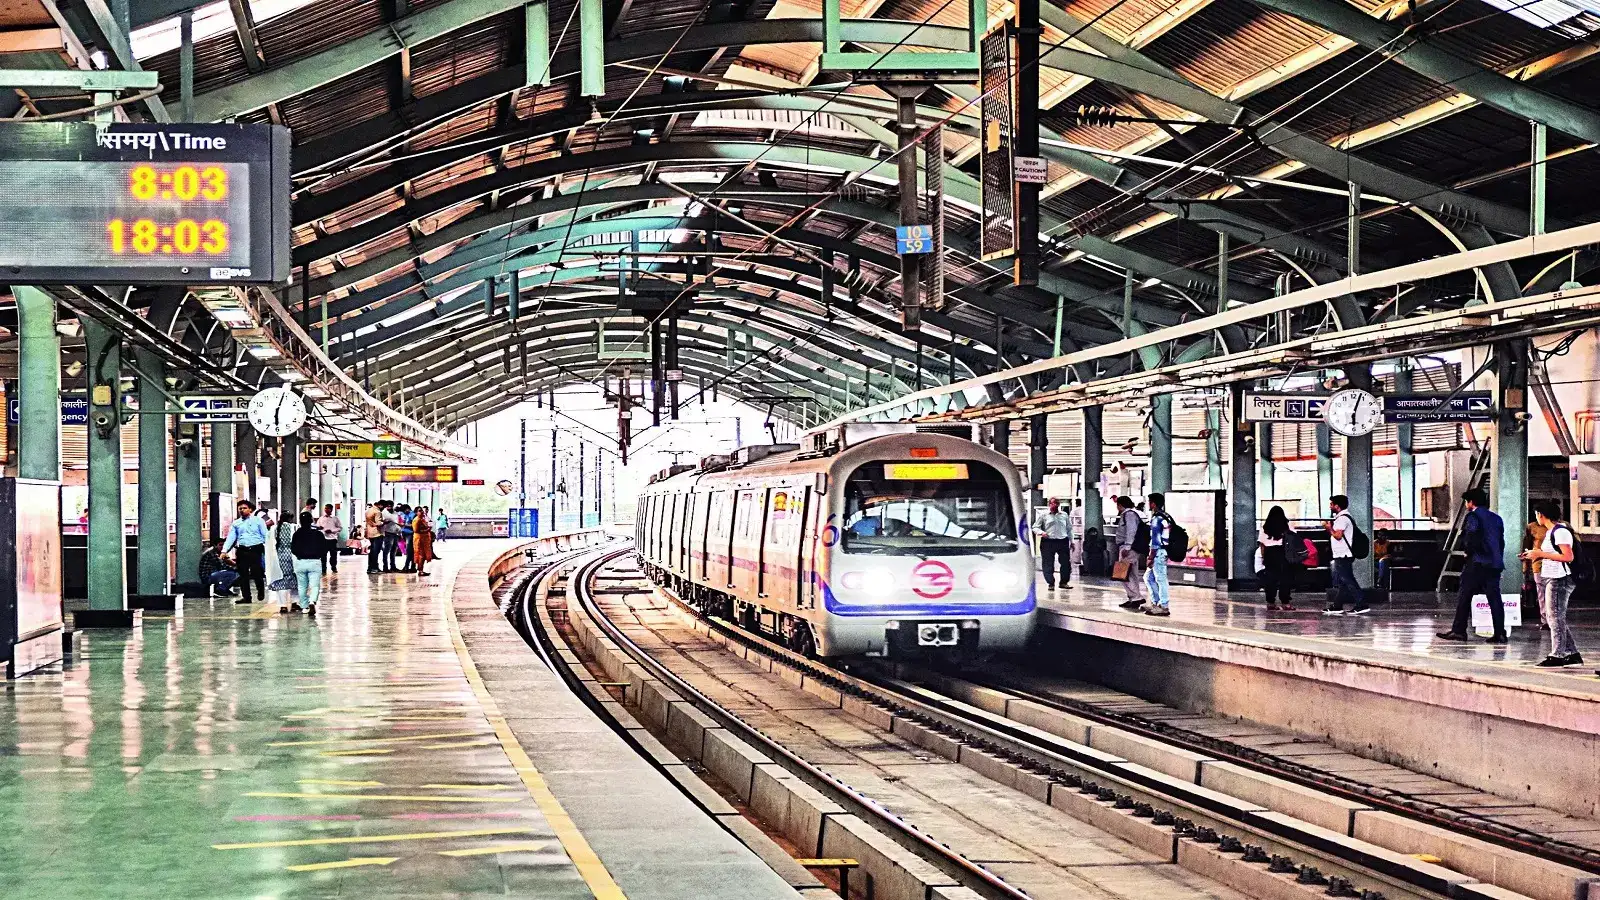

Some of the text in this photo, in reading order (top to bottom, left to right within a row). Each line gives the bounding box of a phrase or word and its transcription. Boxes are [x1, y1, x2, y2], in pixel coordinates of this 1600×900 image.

[131, 165, 227, 201] 8:03
[107, 219, 228, 254] 18:03
[907, 226, 921, 239] 10
[906, 240, 923, 254] 59
[1253, 396, 1281, 408] लिफ्ट
[61, 414, 88, 422] gency
[1264, 410, 1281, 418] Lift
